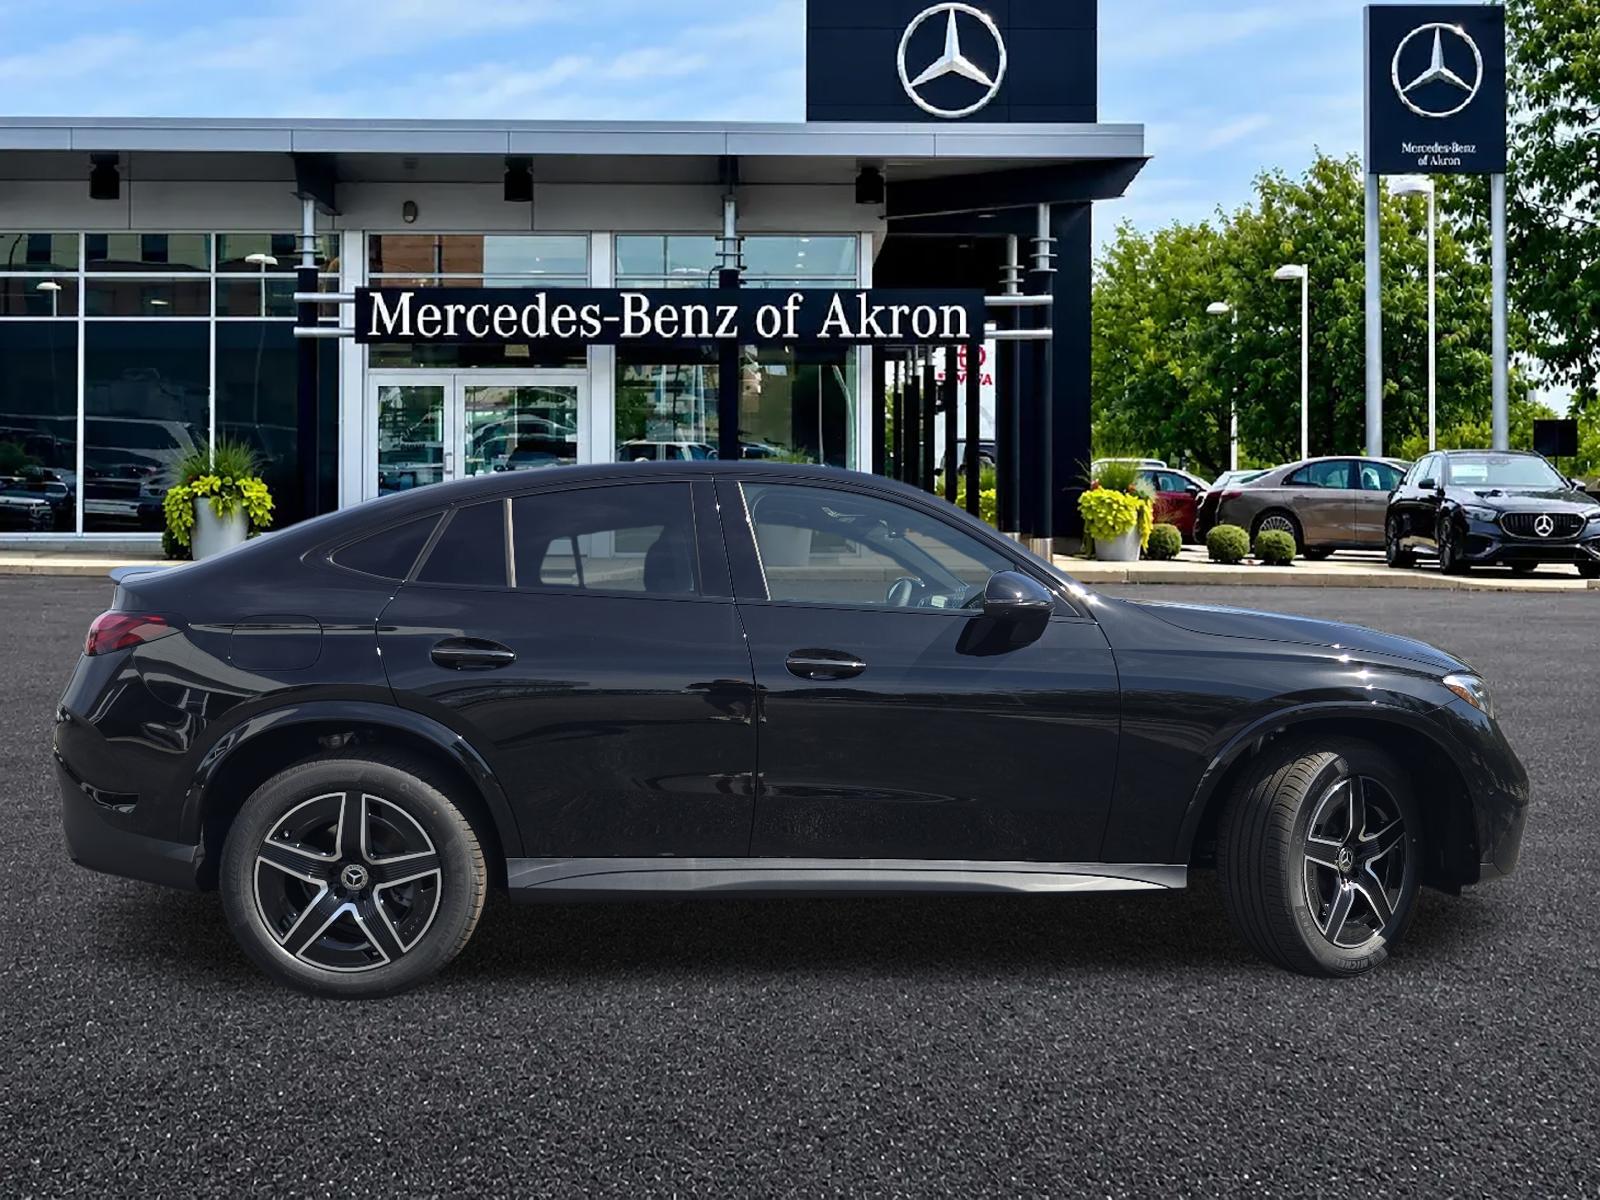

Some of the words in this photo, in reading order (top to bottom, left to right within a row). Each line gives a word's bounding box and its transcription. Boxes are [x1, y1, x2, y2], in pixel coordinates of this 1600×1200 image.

[1401, 142, 1476, 153] Mercedes-Benz
[1417, 154, 1428, 165] of
[1430, 154, 1461, 165] Akron
[367, 291, 738, 338] Mercedes-Benz
[756, 291, 804, 338] of
[817, 291, 970, 338] Akron
